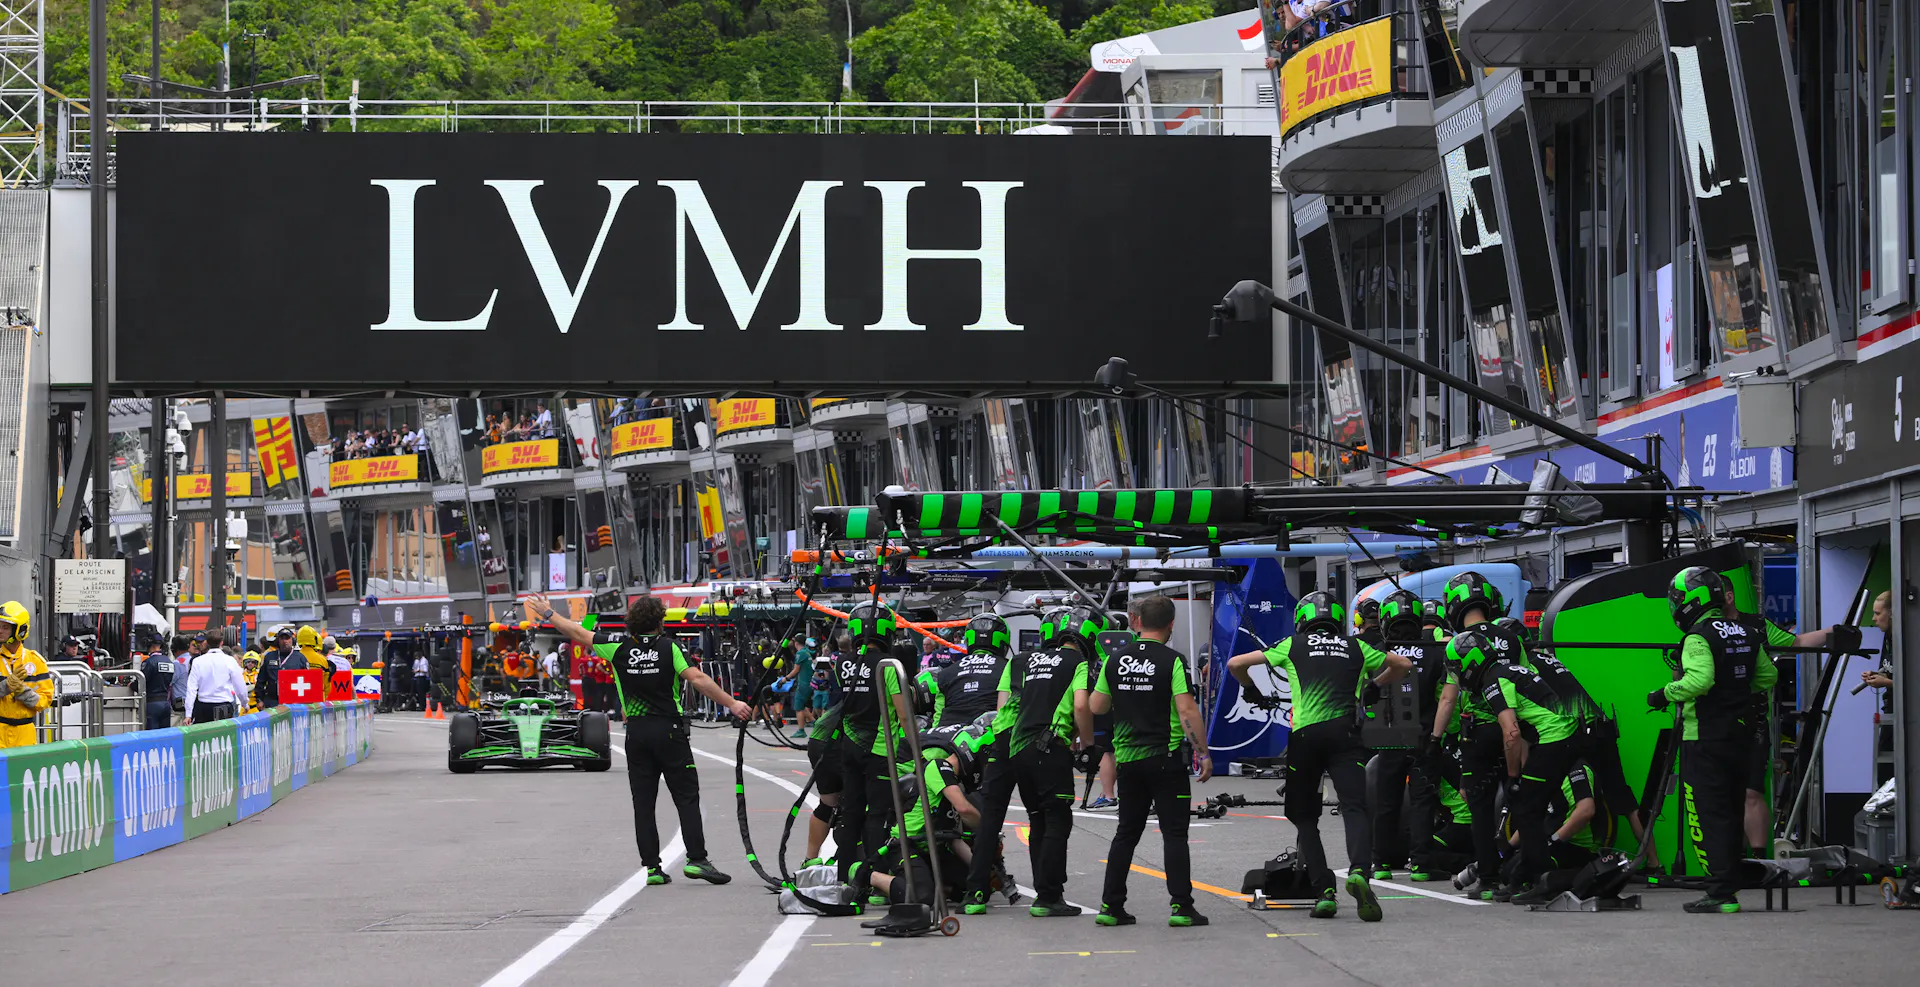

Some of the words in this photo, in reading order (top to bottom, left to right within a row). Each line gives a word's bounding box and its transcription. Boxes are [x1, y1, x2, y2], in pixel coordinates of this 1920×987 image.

[1304, 40, 1359, 107] DHL
[371, 179, 1024, 333] LVMH
[732, 400, 760, 424] DHL
[1894, 376, 1902, 442] 5
[631, 423, 657, 446] DHL
[1703, 434, 1717, 477] 23
[367, 460, 401, 479] DHL
[1730, 456, 1756, 479] ALBON
[1307, 632, 1348, 648] Stake
[1712, 621, 1747, 638] Stake
[628, 648, 659, 665] Stake
[959, 654, 997, 667] Stake
[1029, 652, 1063, 668] Stake
[1118, 655, 1156, 676] Stake
[841, 660, 871, 679] Stke
[333, 680, 349, 692] W
[242, 727, 270, 799] aramco
[191, 735, 234, 819] aramco
[123, 746, 177, 838] aramco
[23, 759, 105, 862] aramco
[1684, 781, 1704, 842] CREW
